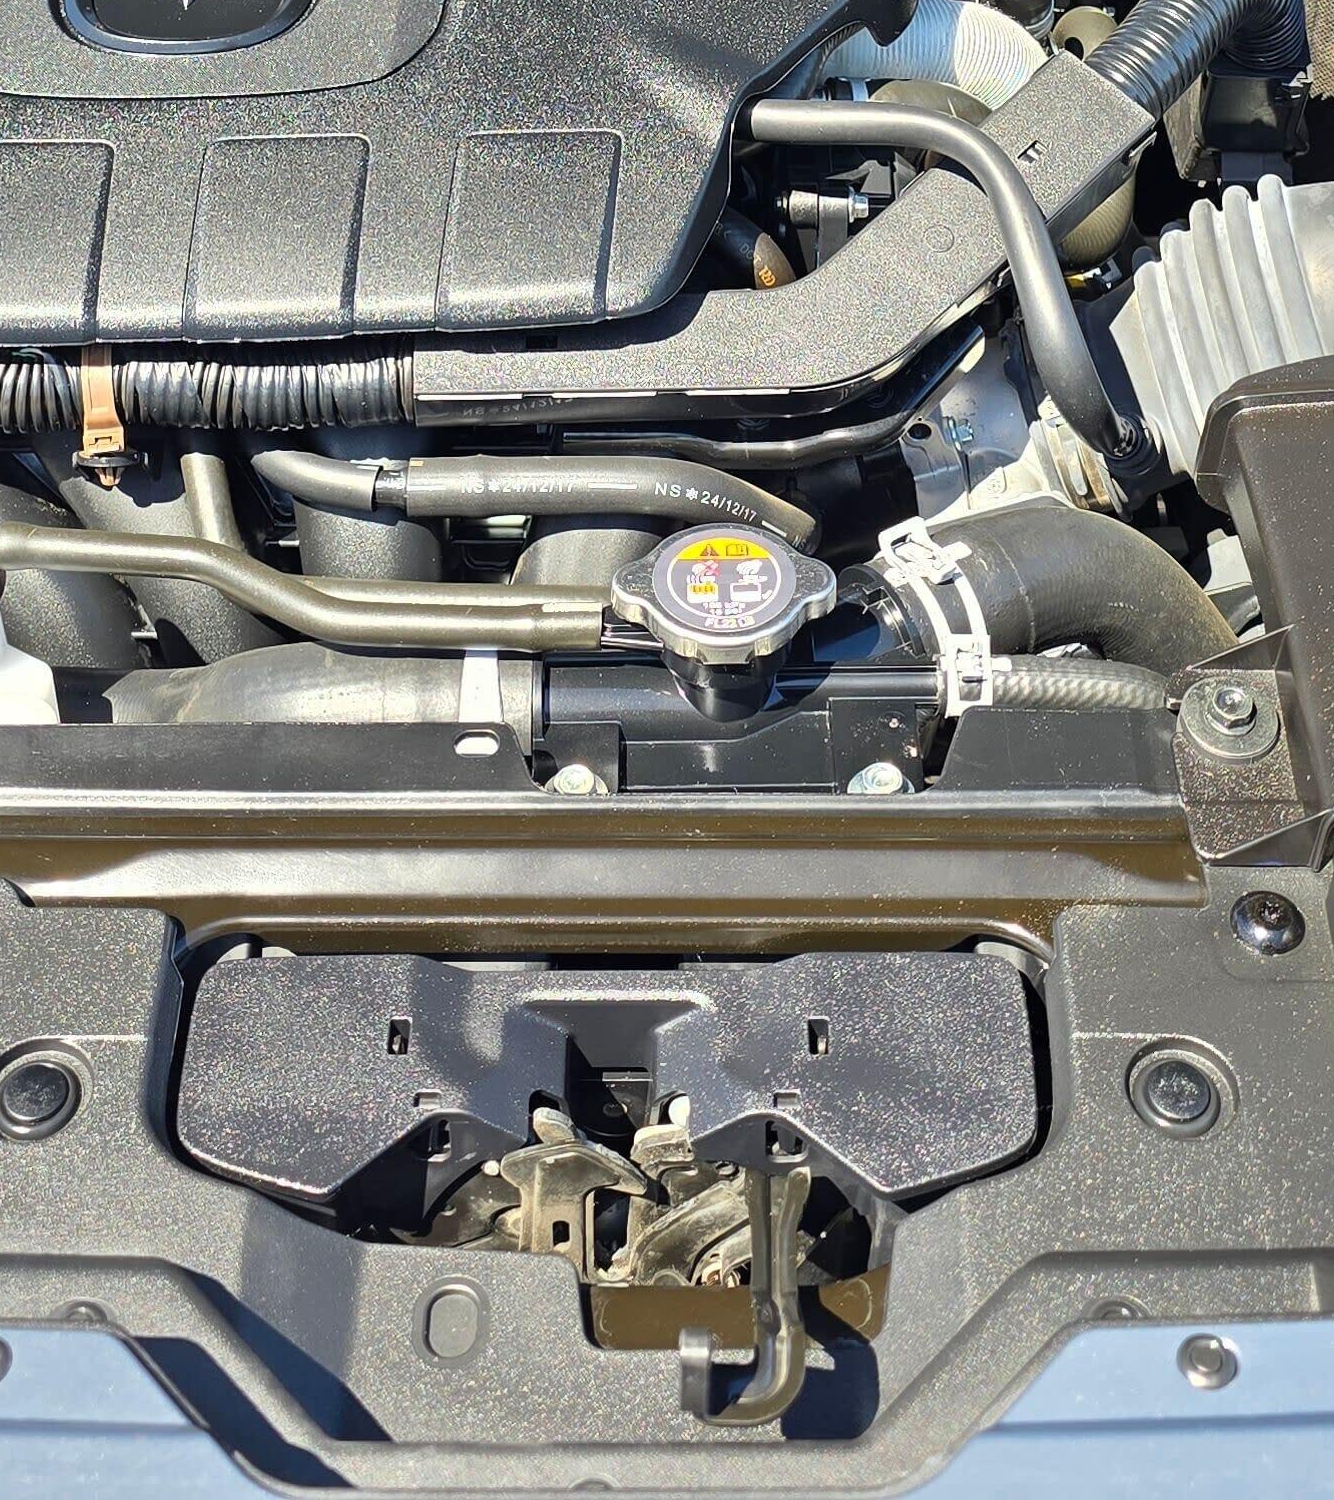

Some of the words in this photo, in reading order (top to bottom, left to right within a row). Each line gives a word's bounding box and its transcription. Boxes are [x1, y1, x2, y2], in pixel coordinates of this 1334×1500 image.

[460, 483, 485, 494] NS
[502, 482, 575, 494] 24/12/17
[654, 482, 682, 499] NS
[700, 490, 758, 522] 24/12/17
